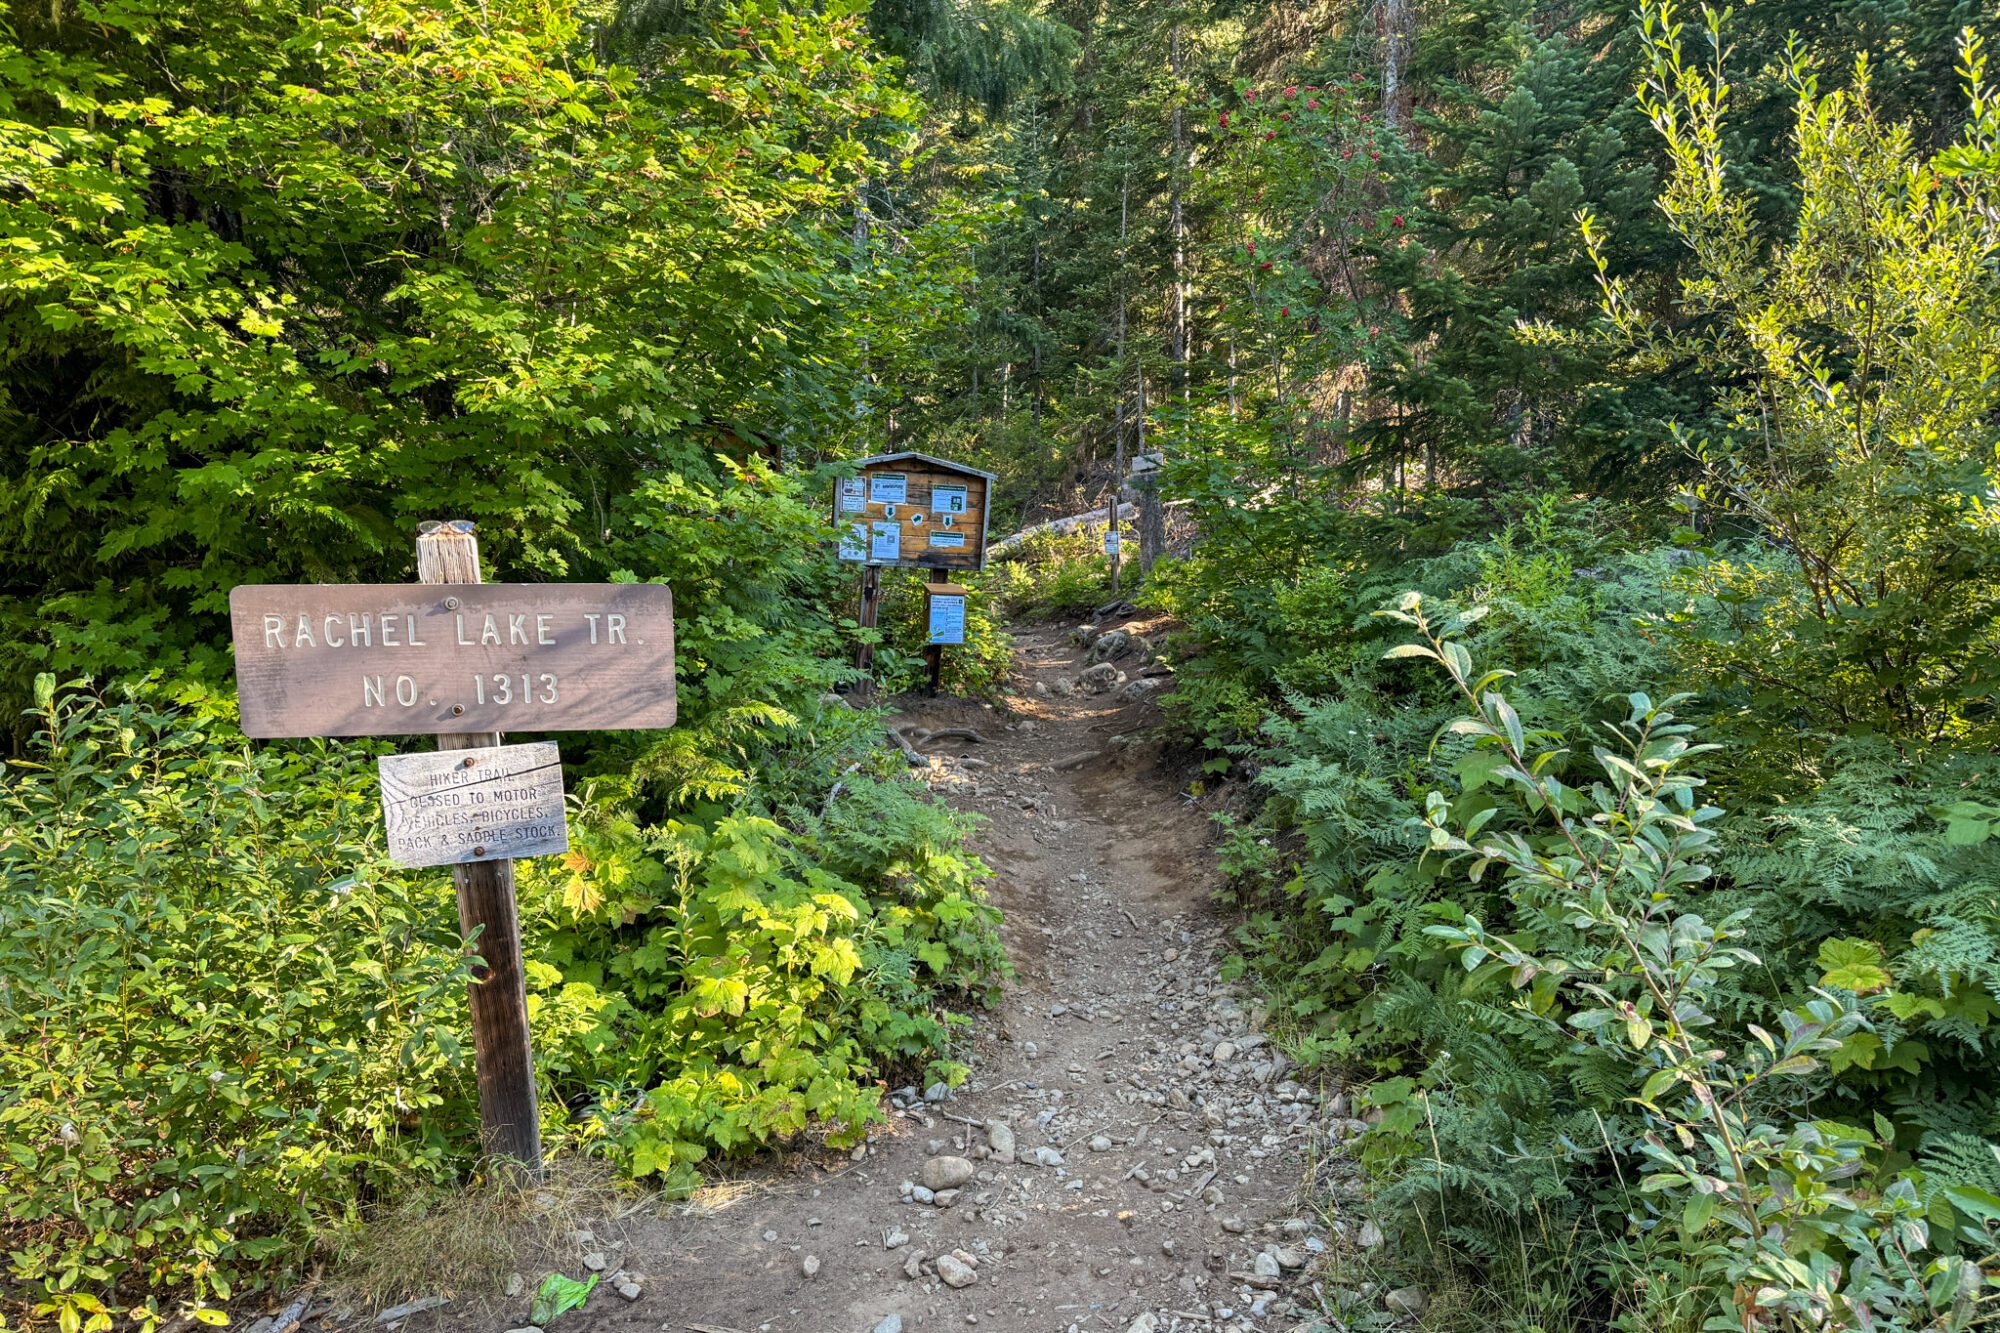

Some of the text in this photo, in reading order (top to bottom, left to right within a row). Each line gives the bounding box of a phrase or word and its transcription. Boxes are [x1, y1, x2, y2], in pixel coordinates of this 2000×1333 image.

[263, 613, 646, 648] RACHEL LAKE TR.
[363, 672, 560, 707] NO. 1313
[430, 768, 515, 787] HIKER TRAIL
[469, 791, 484, 805] TO
[493, 788, 537, 803] MOTOR
[398, 825, 561, 851] PACK & SADDLE STOCK.
